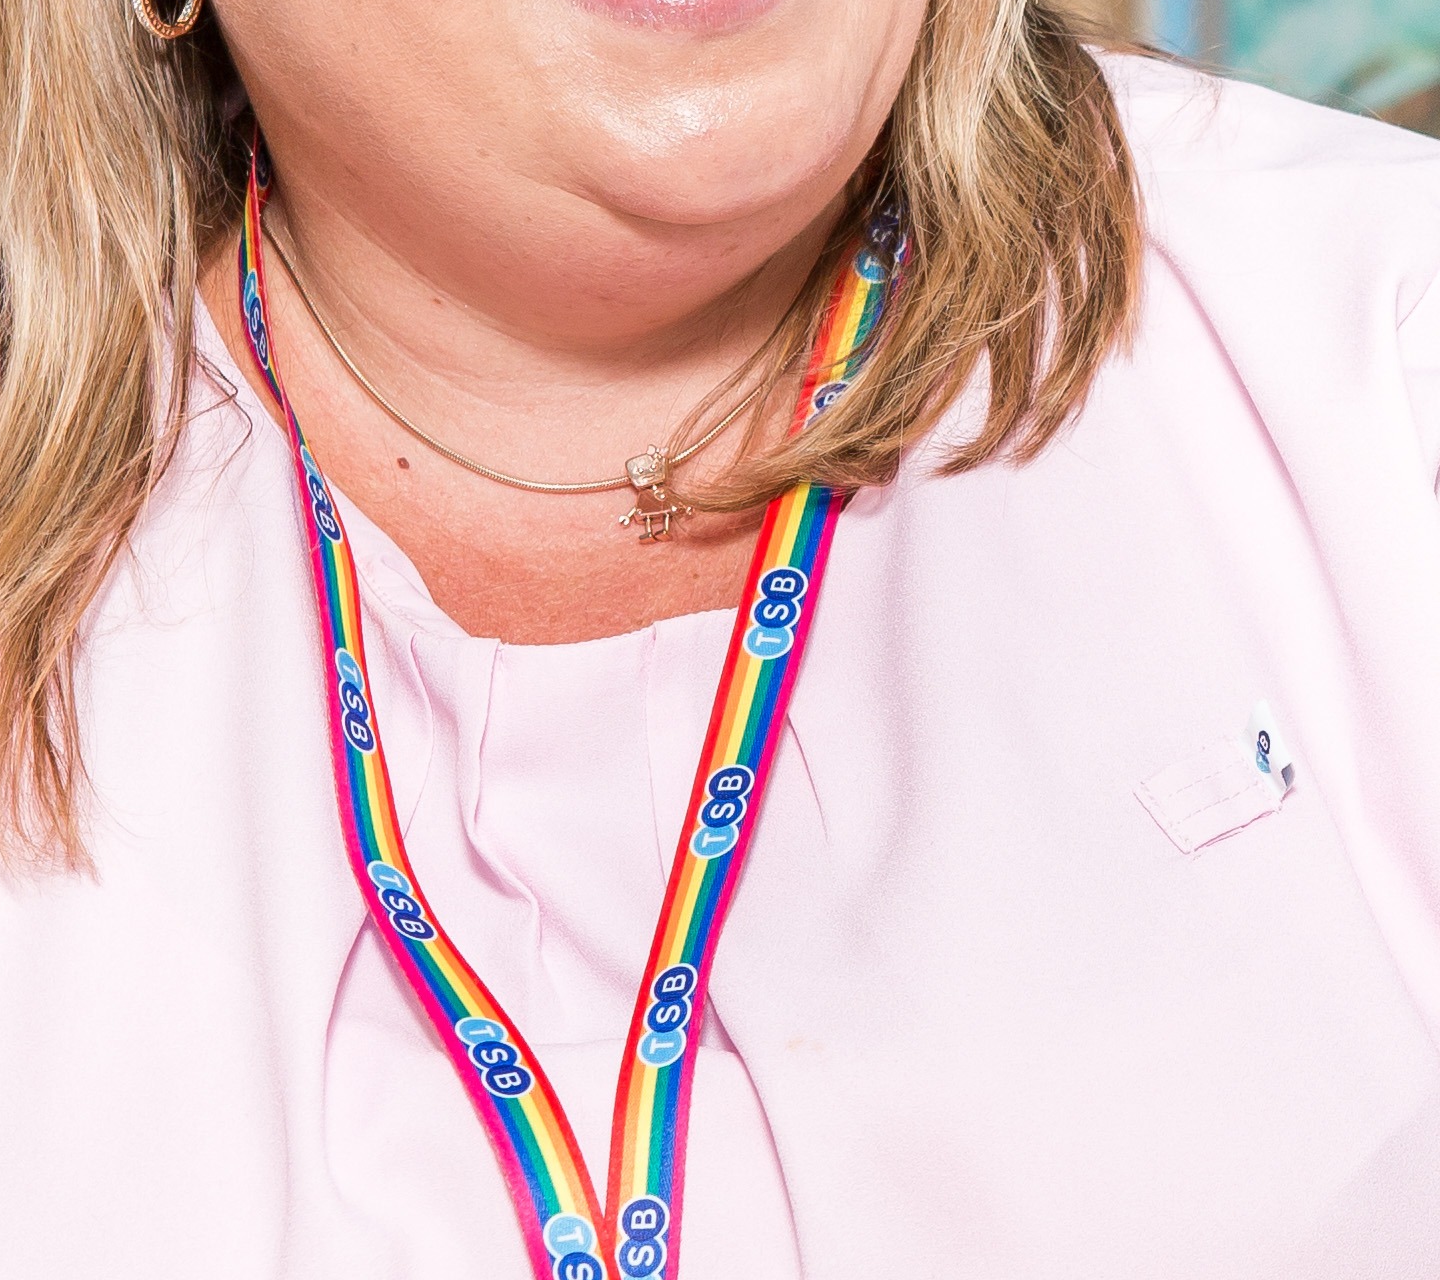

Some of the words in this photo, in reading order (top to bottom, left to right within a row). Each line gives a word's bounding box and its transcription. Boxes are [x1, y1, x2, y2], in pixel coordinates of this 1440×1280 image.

[750, 570, 804, 654] TSB
[338, 656, 373, 749] TSB
[696, 768, 750, 852] TSB
[372, 866, 432, 938] TSB
[642, 968, 693, 1060] TSB
[461, 1020, 528, 1094] TSB
